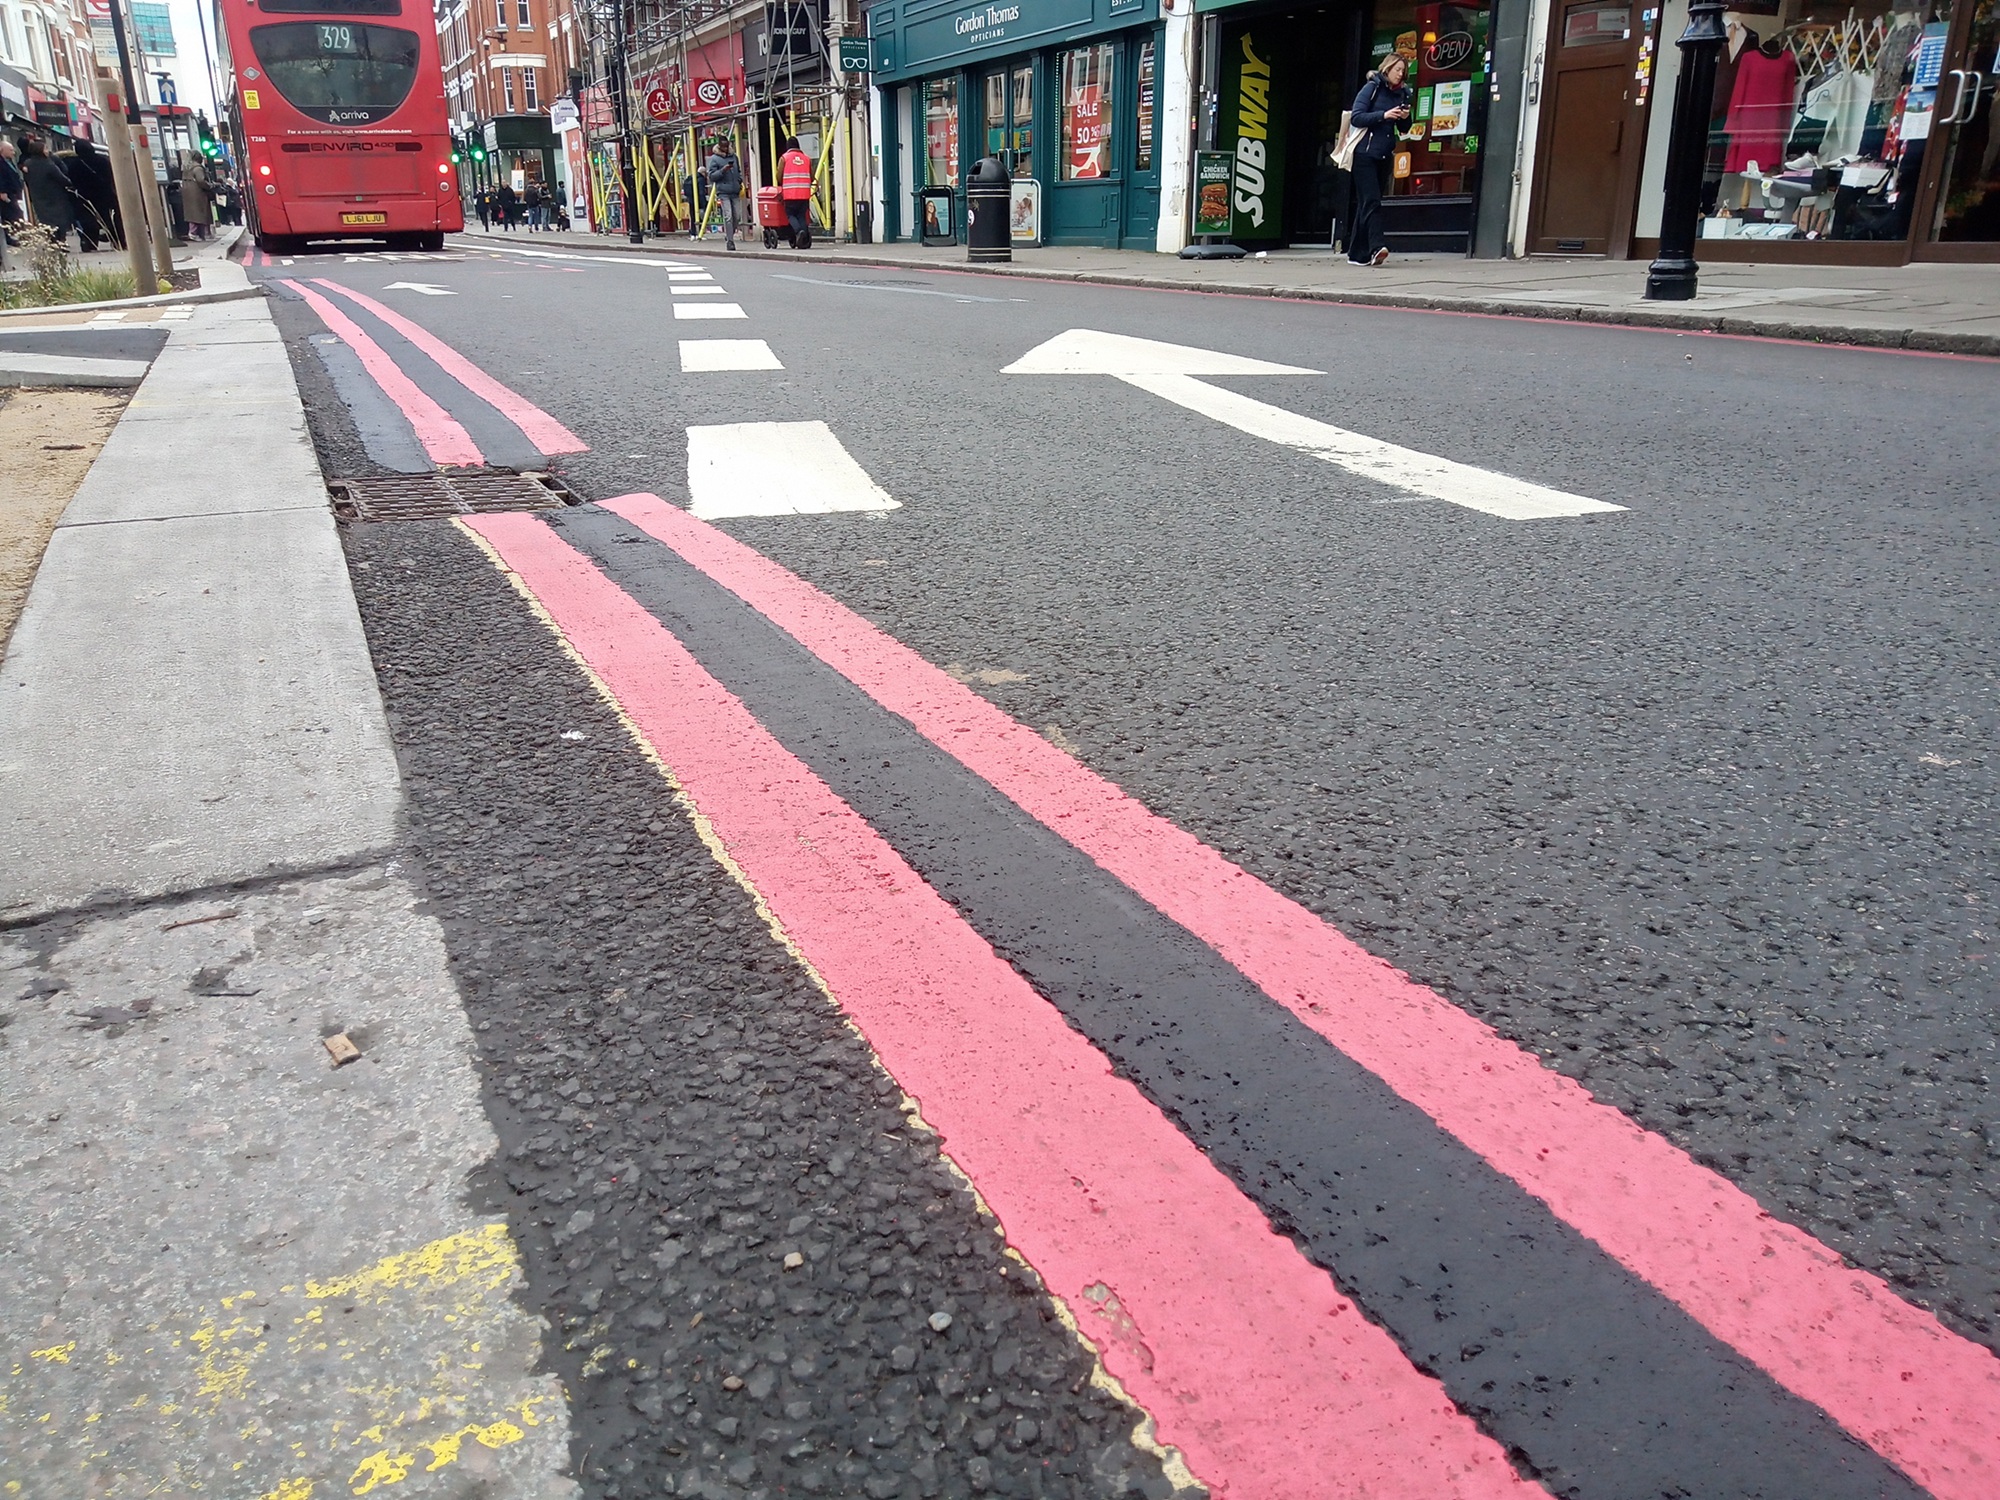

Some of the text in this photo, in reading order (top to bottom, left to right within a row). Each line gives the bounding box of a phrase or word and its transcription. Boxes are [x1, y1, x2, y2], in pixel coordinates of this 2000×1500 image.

[955, 5, 1020, 35] Gordon Thomas
[321, 26, 350, 49] 329
[970, 28, 1005, 43] OPTICIANS
[1430, 38, 1467, 62] OPEN
[340, 110, 370, 120] arriva
[1077, 102, 1098, 118] SALE
[949, 124, 958, 135] SA
[1234, 31, 1271, 229] SUBWAY
